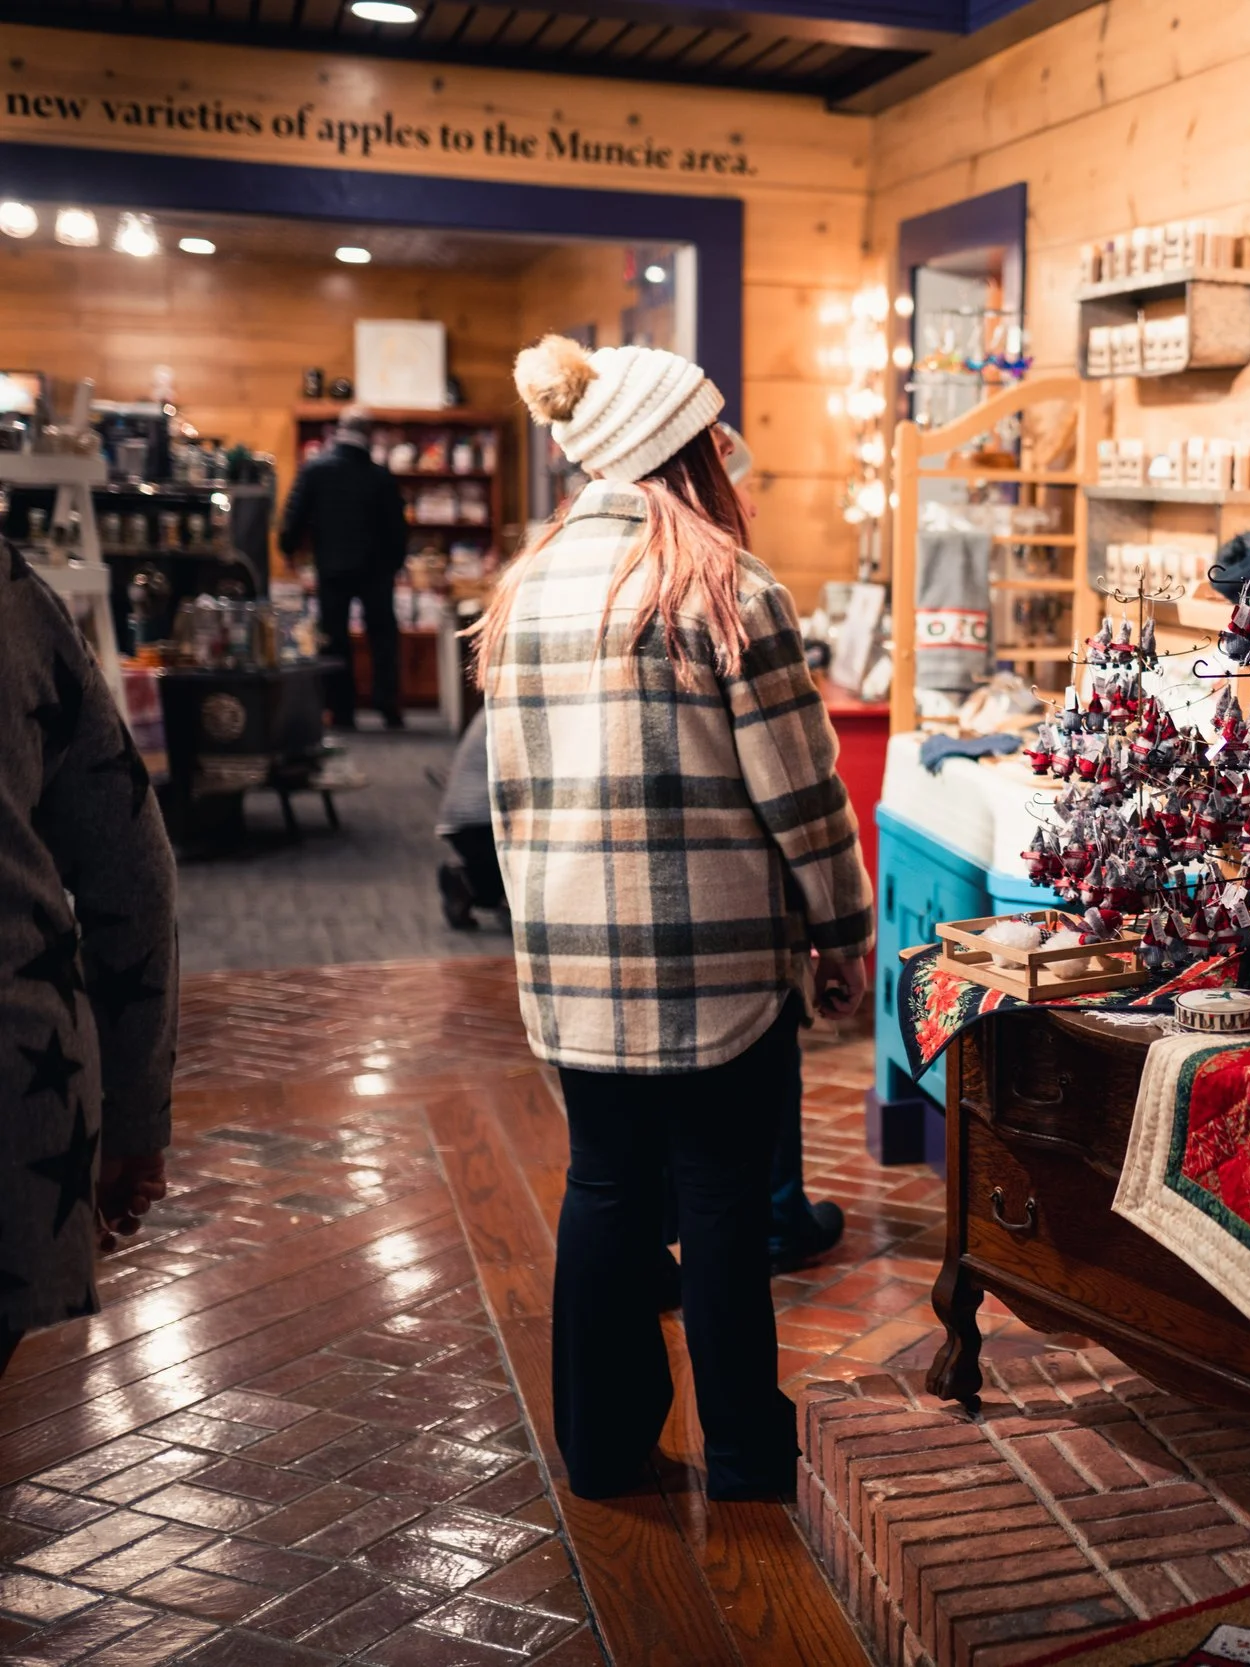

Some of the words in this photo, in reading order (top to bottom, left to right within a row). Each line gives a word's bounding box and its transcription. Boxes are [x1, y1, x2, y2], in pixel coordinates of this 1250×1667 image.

[5, 91, 84, 121] new
[99, 95, 263, 137] varieties
[271, 103, 315, 141] of
[317, 110, 430, 156] apples
[440, 118, 474, 152] to
[483, 118, 538, 158] the
[545, 126, 672, 170] Muncie
[679, 152, 759, 177] area.
